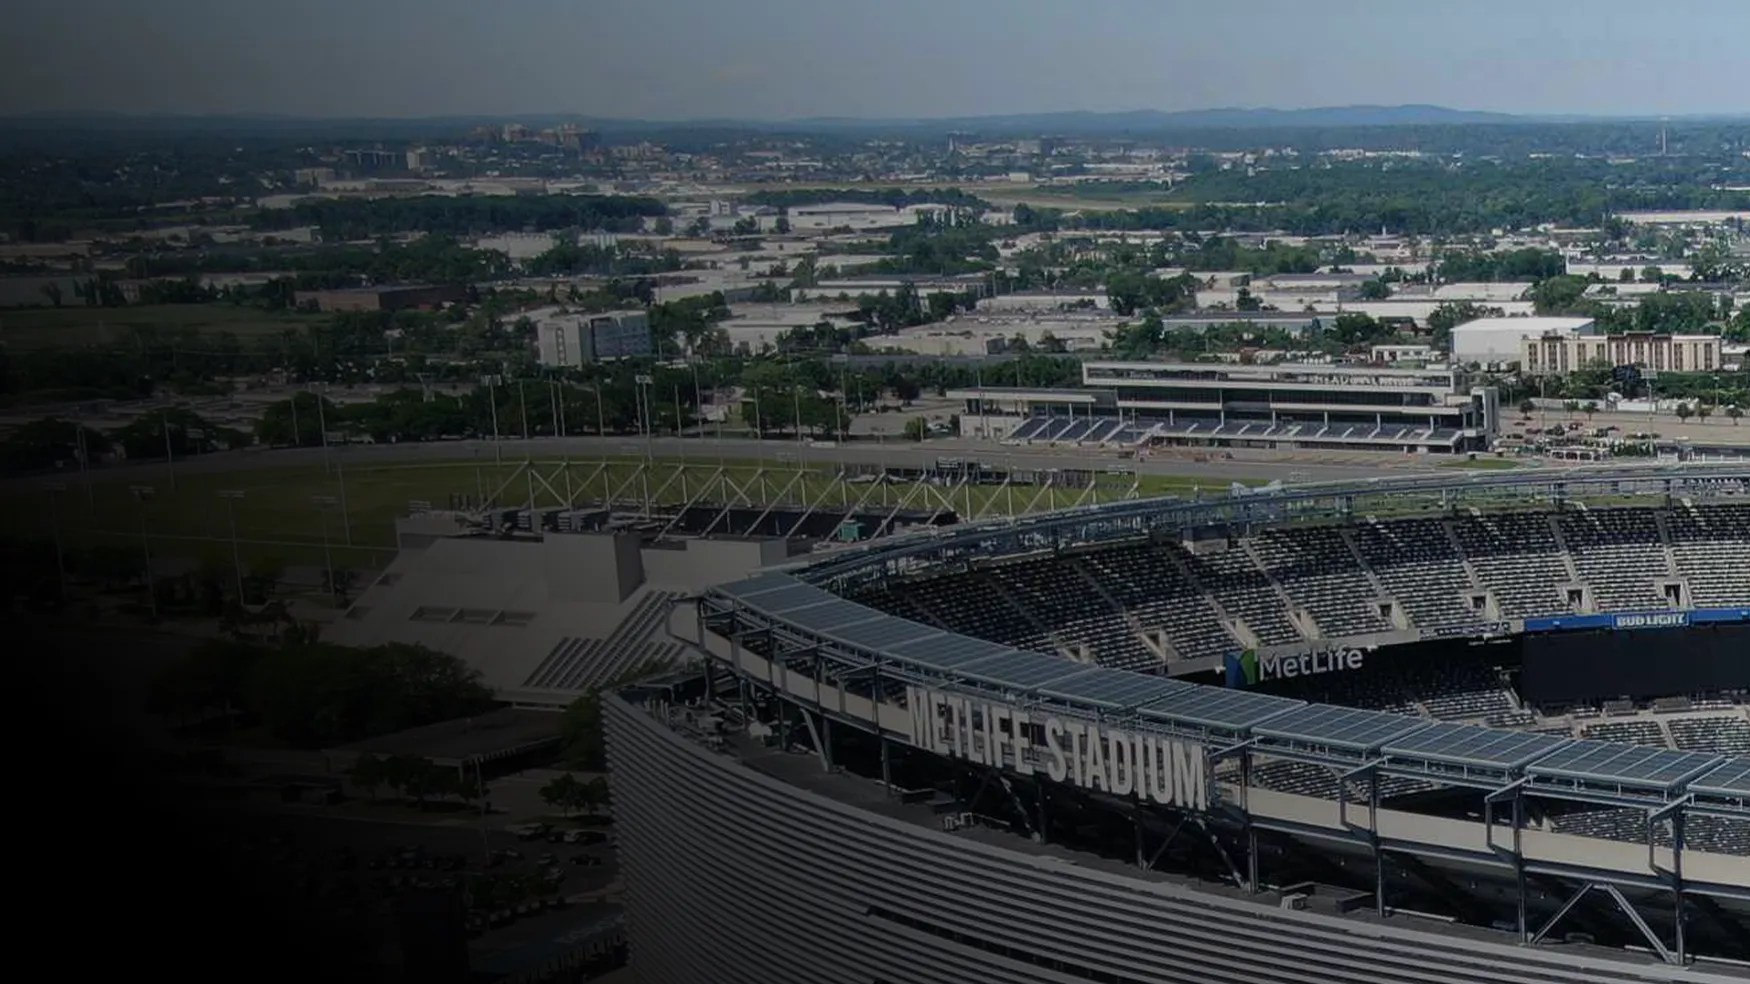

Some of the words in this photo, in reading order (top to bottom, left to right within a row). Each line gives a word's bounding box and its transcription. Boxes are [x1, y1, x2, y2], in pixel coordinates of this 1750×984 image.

[1616, 615, 1645, 627] BUD
[1645, 613, 1685, 626] LIGHT
[1259, 645, 1364, 681] MetLife
[906, 686, 1034, 776] METLIFE
[1044, 718, 1208, 812] STADIUM
